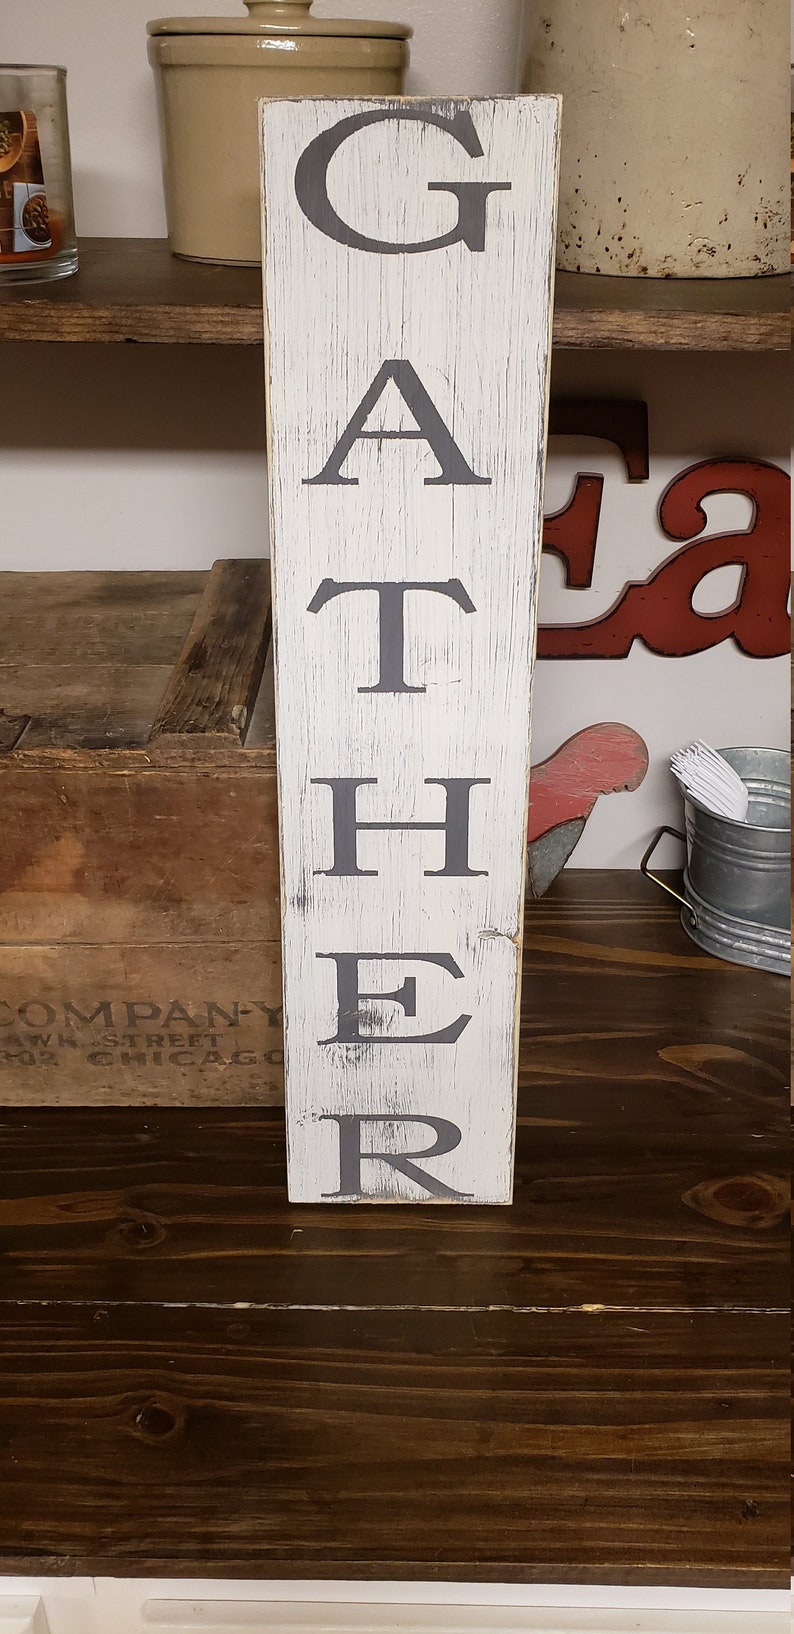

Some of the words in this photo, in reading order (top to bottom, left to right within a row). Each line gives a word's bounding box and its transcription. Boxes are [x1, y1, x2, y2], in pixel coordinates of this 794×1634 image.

[294, 107, 512, 1199] GATHER
[102, 1032, 224, 1048] STREET
[86, 1049, 284, 1067] CHICAGO
